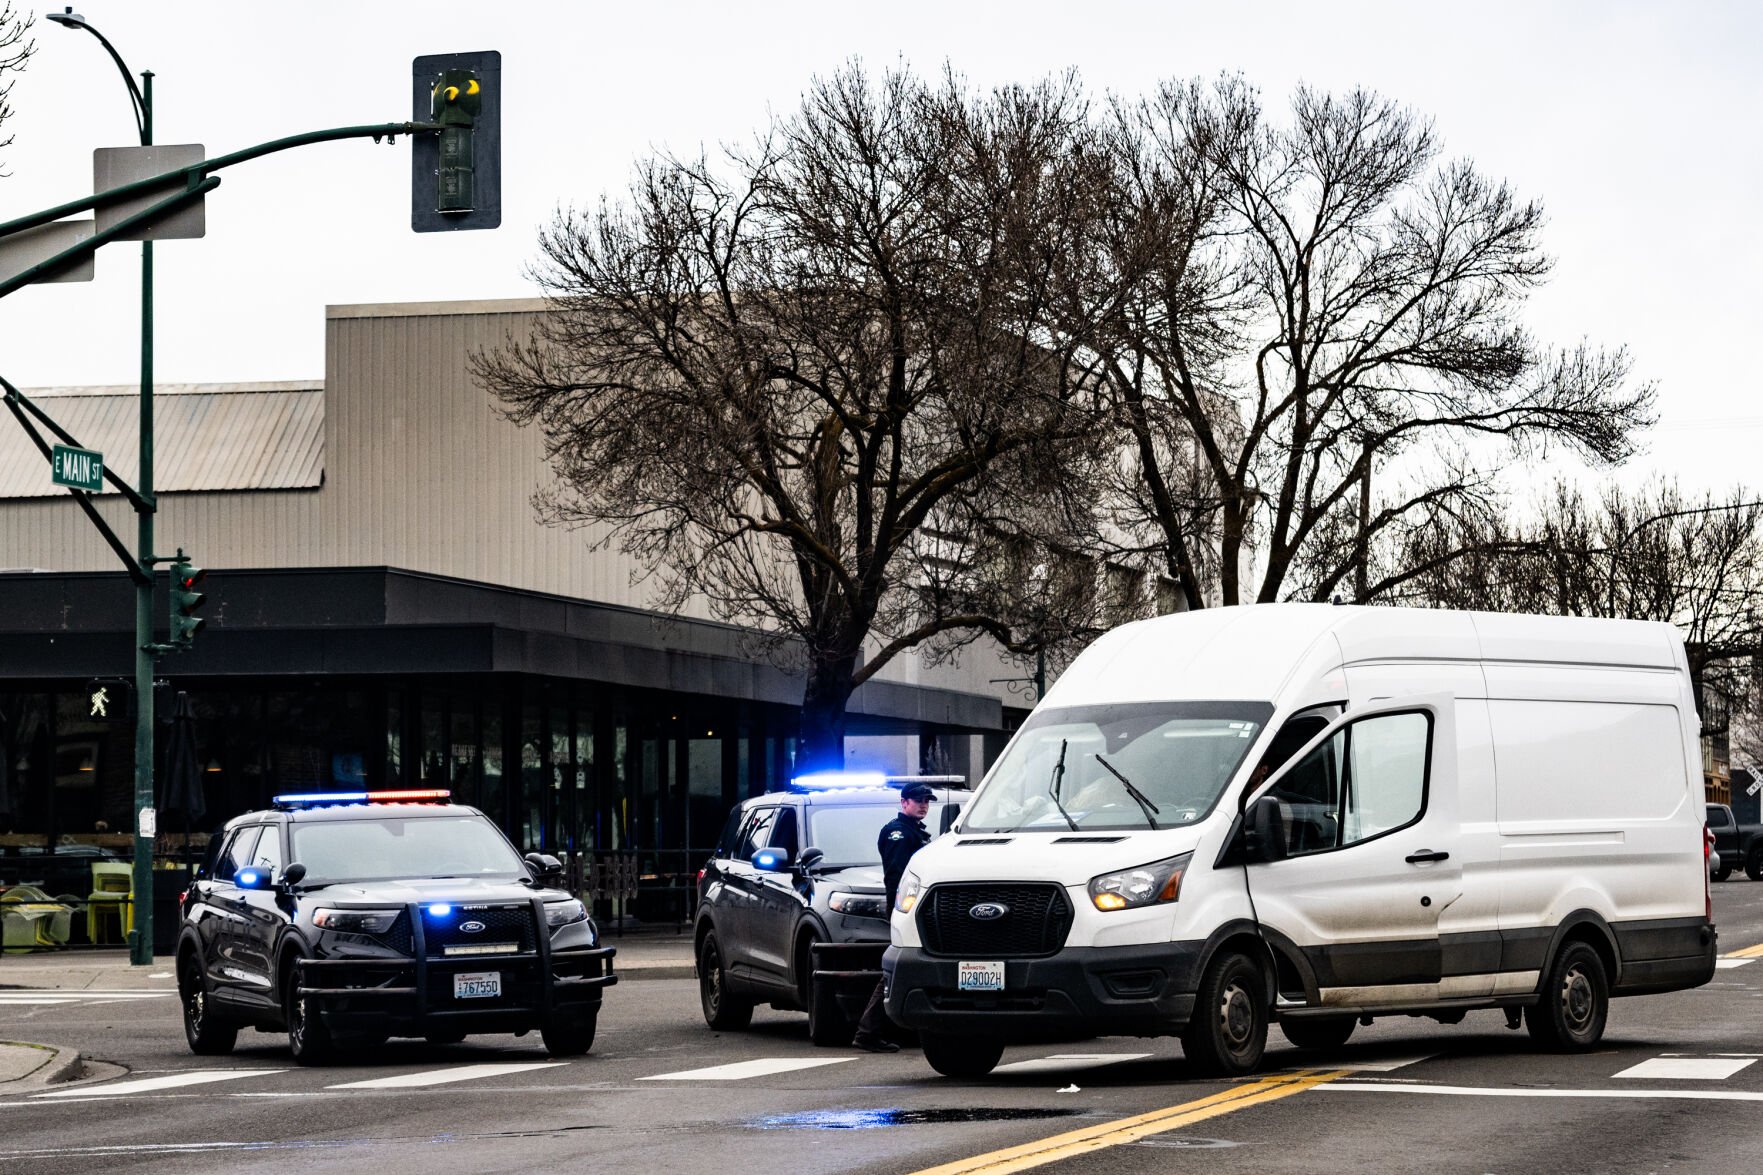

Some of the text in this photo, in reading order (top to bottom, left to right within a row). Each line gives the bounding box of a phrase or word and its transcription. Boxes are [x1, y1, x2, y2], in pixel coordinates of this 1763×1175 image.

[55, 451, 100, 484] E MAIN ST
